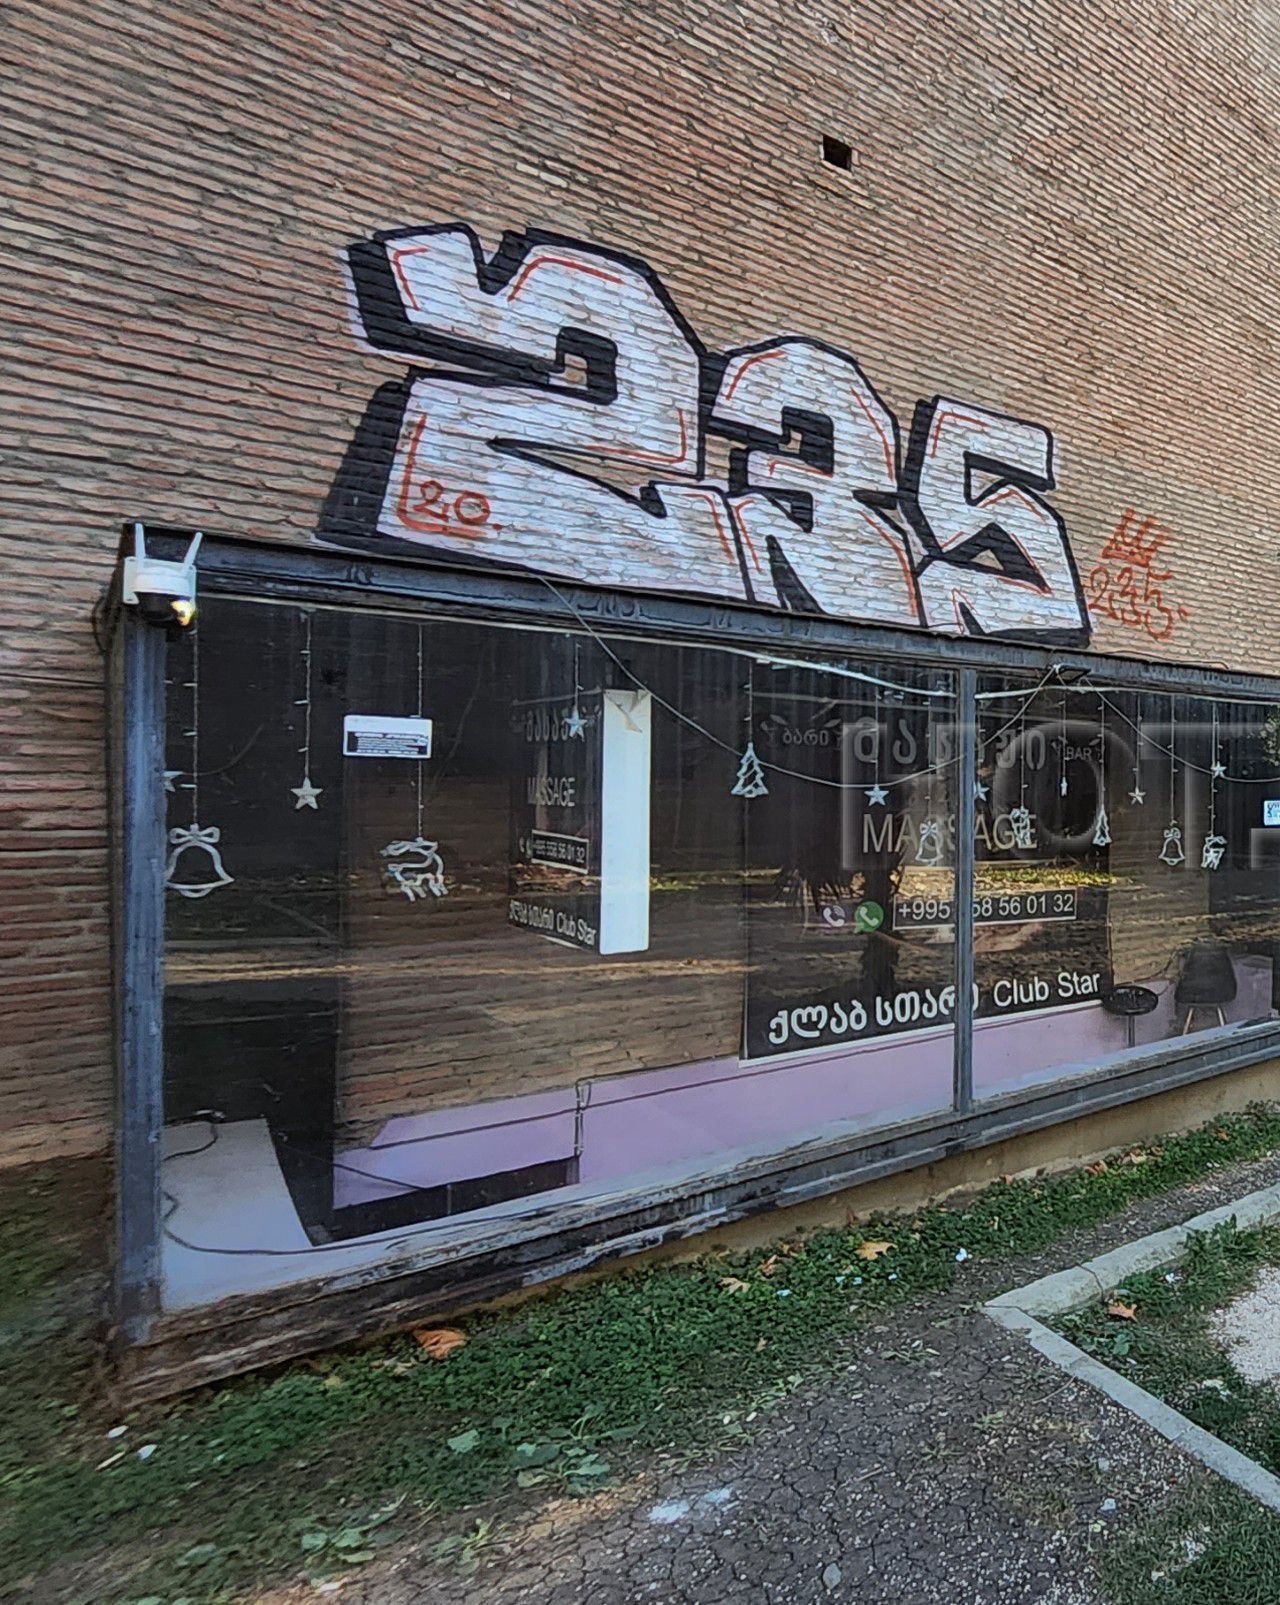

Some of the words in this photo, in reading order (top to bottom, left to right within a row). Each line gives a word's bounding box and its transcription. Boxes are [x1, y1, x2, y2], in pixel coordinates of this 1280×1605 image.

[1066, 747, 1092, 760] BAR
[898, 899, 951, 921] +995
[967, 900, 992, 918] 58
[999, 897, 1021, 917] 56
[1026, 895, 1046, 915] 01
[1053, 893, 1074, 913] 32
[993, 977, 1049, 1007] Club
[1057, 971, 1102, 997] Star
[768, 999, 868, 1045] ქლაბ
